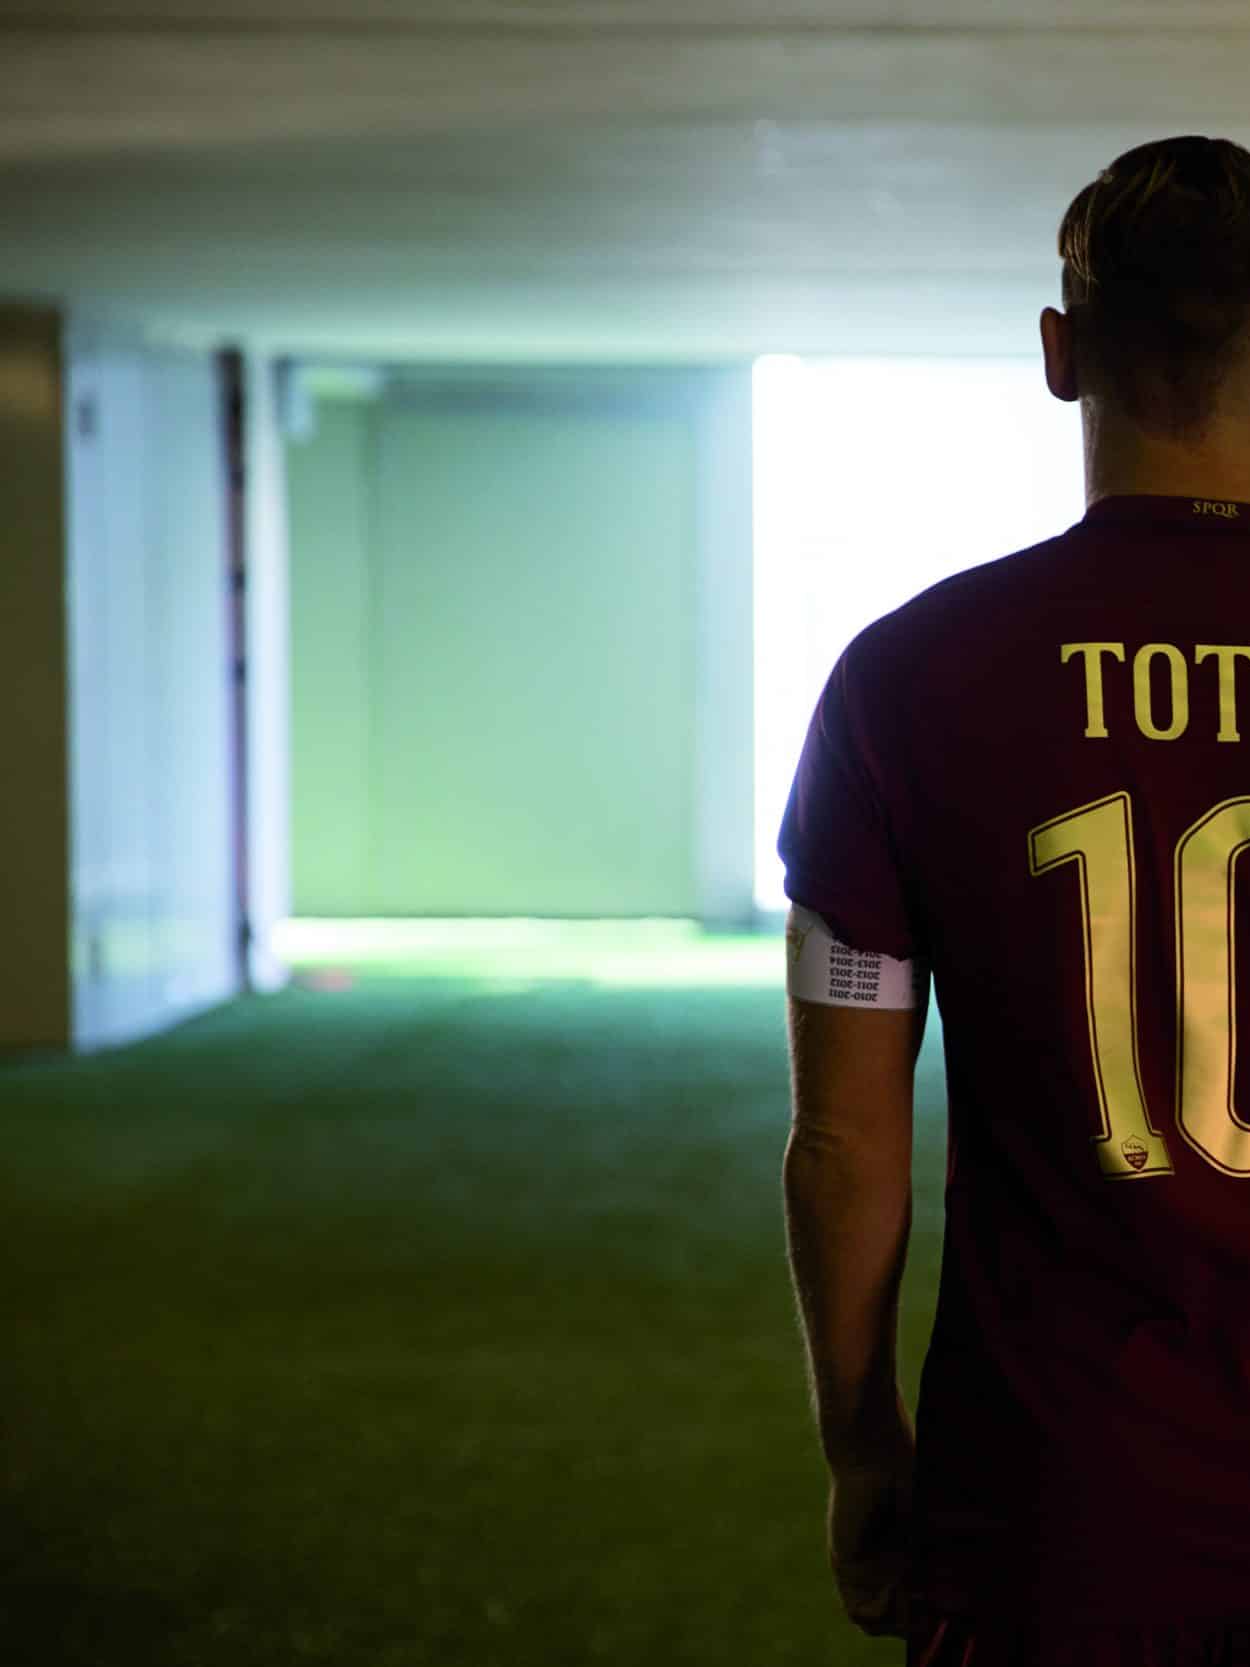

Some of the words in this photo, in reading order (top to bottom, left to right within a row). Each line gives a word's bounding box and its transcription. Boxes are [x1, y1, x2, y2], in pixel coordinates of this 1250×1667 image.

[1193, 502, 1240, 519] SPQR
[829, 956, 881, 969] 2013-2014
[829, 967, 881, 980] 2012-2013
[829, 978, 879, 991] 2011-2012
[828, 989, 878, 1002] 2010-2011
